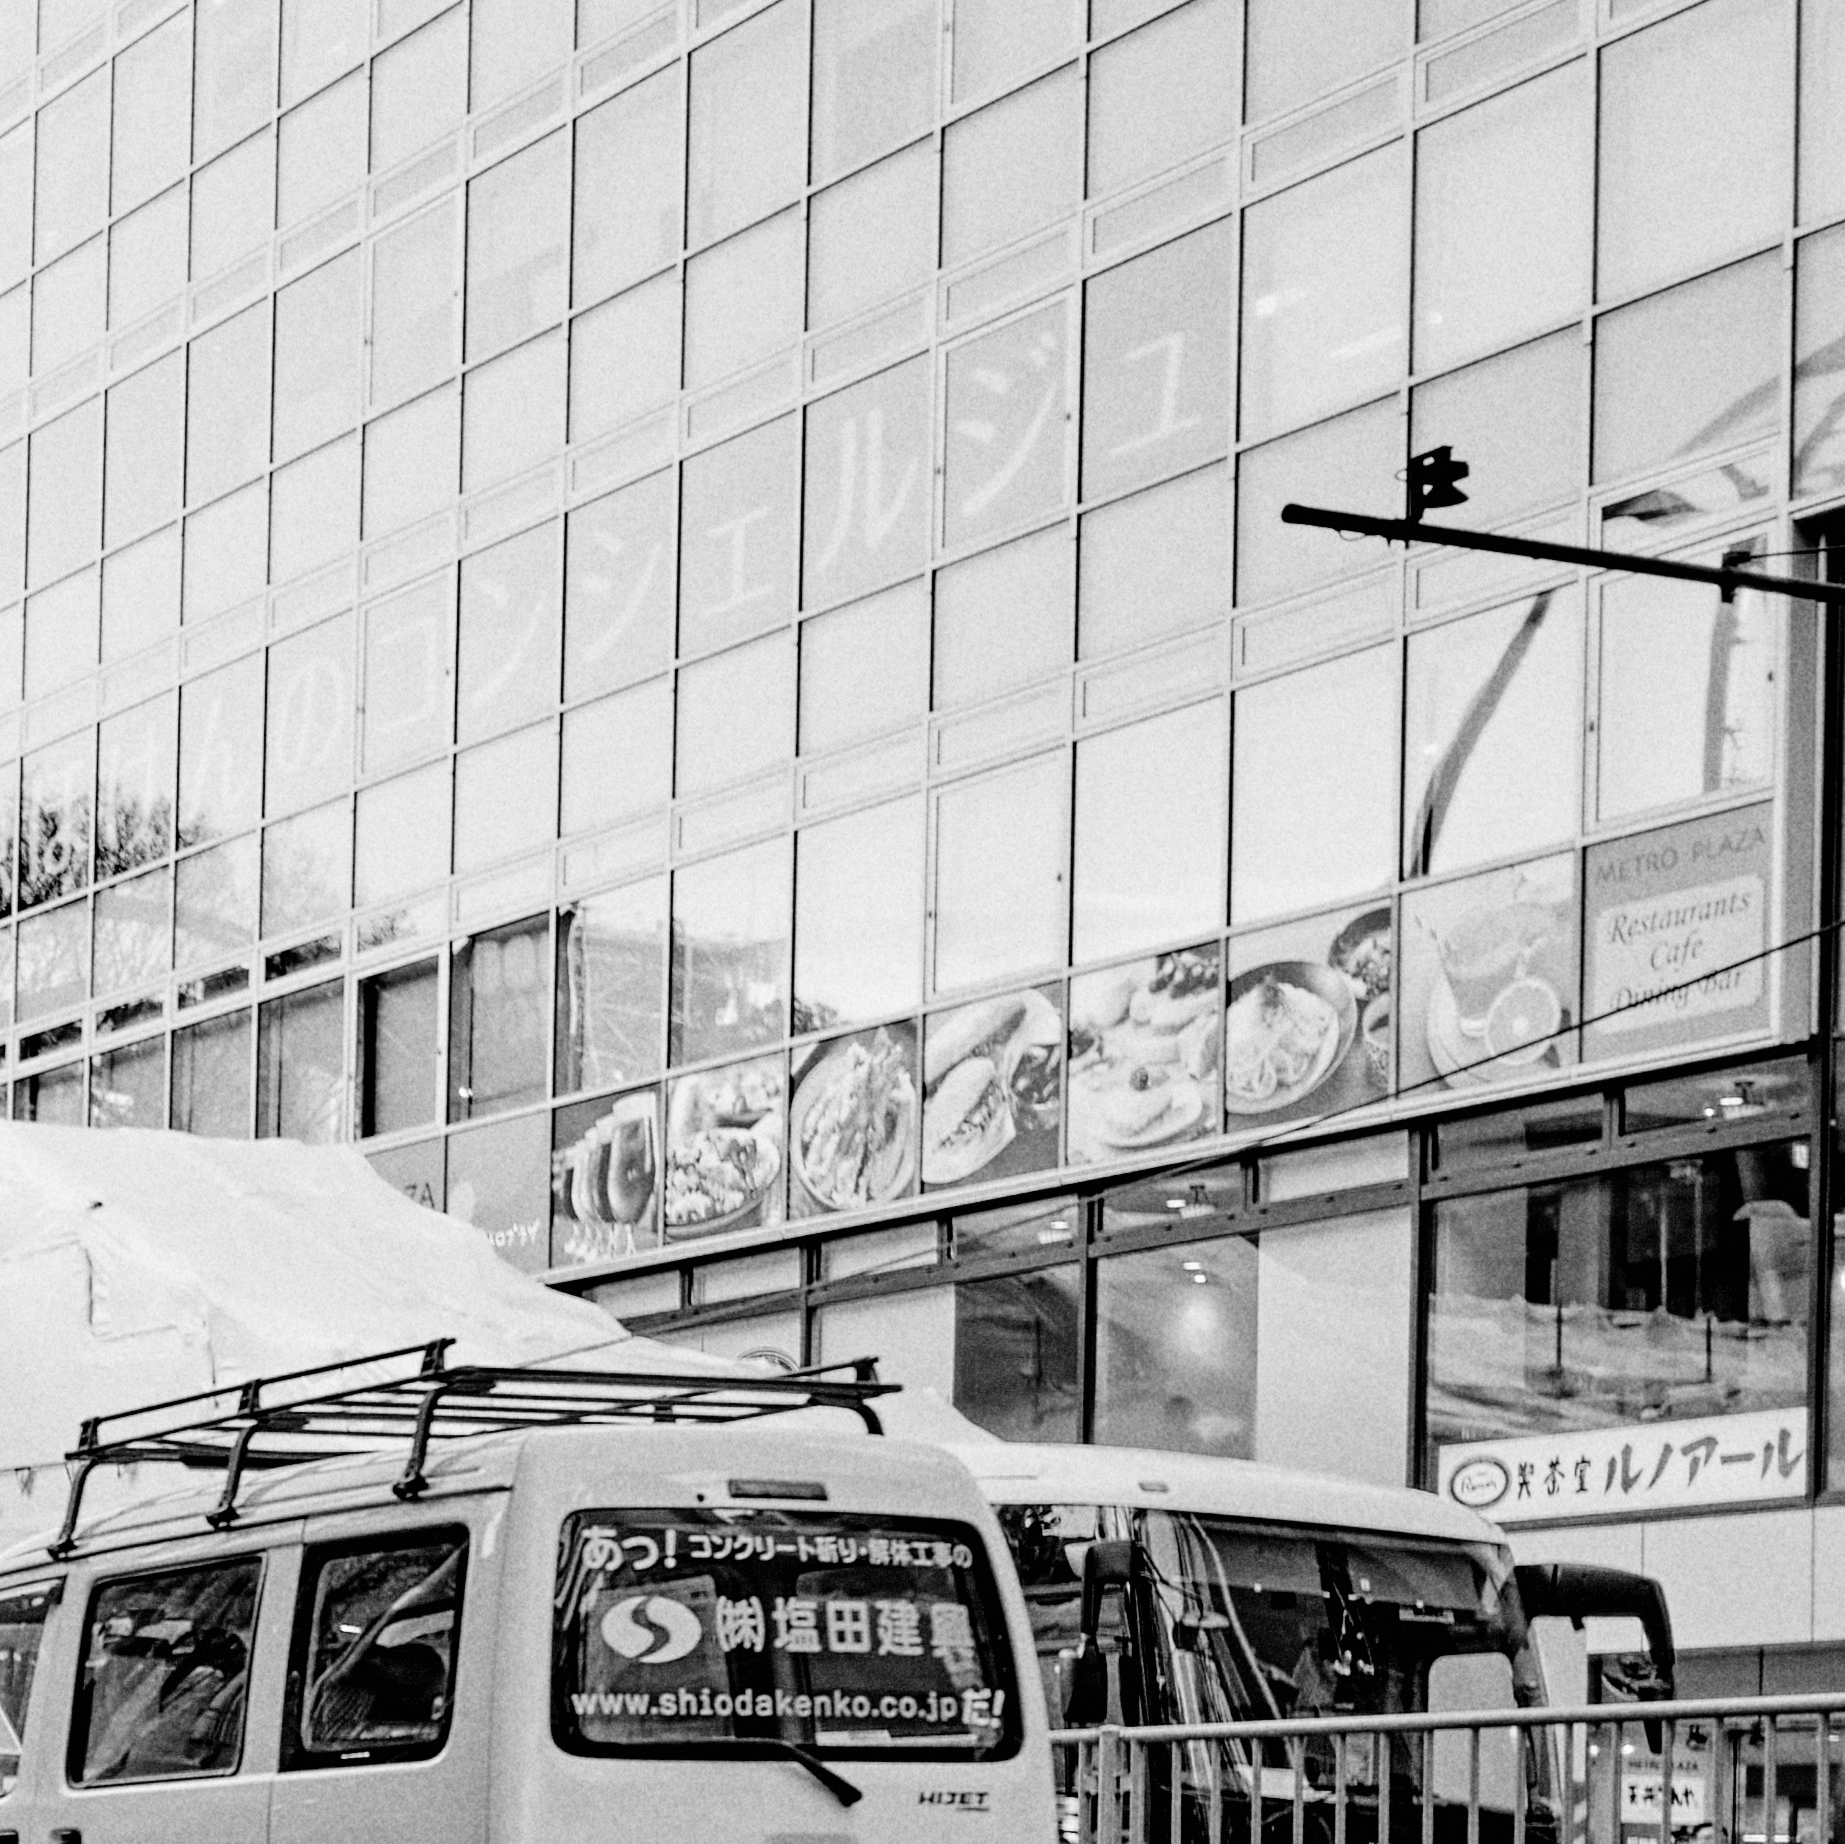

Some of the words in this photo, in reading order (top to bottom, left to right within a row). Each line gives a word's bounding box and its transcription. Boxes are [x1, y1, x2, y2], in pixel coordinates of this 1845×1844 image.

[1593, 846, 1680, 885] METRO
[1691, 827, 1767, 862] PLAZA
[1608, 891, 1751, 945] Restaurants
[1603, 1428, 1804, 1496] ルノアール
[582, 1525, 678, 1572] あっ！
[571, 1686, 959, 1723] www.shiodakenko.co.jp
[917, 1791, 990, 1806] HIJET
